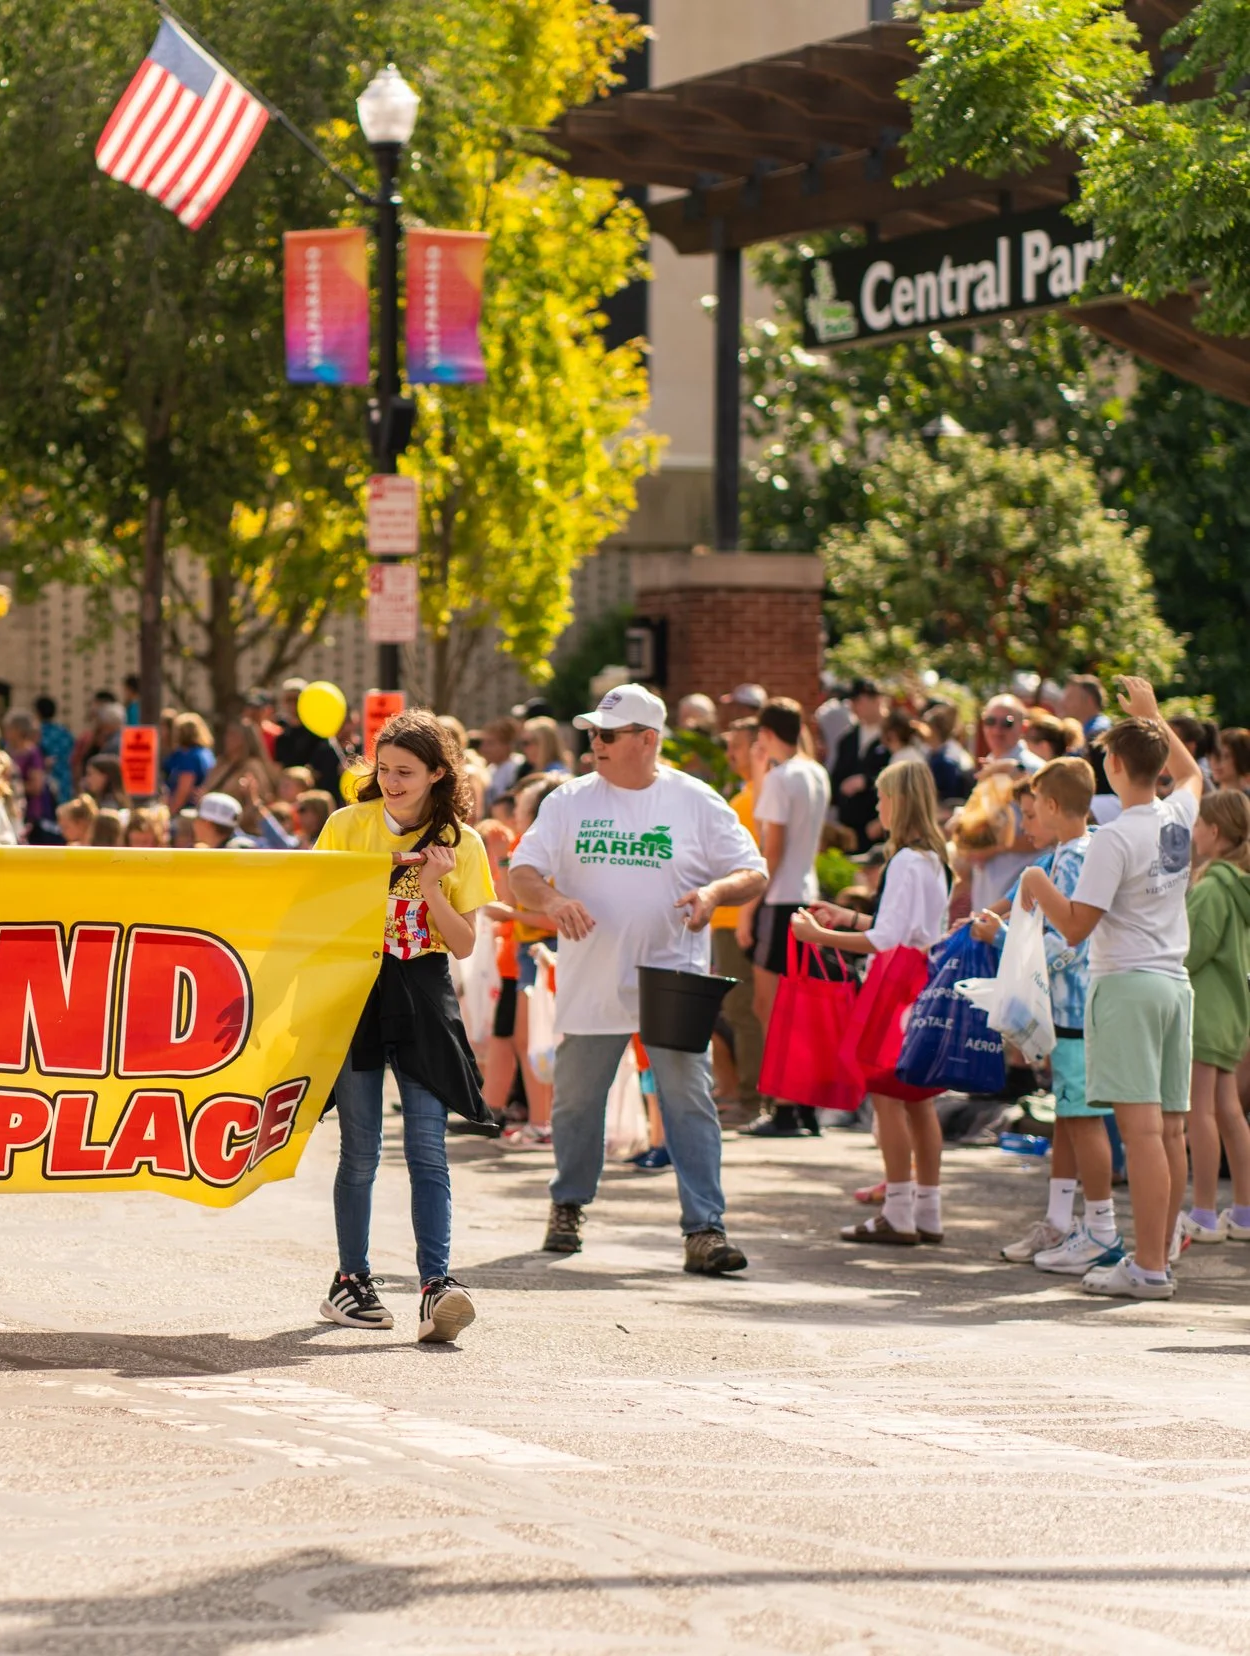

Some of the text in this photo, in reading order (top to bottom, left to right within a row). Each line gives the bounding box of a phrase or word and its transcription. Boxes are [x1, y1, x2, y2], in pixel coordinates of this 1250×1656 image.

[861, 236, 1011, 331] Central
[580, 819, 614, 828] ELECT
[578, 829, 635, 840] MICHELLE
[575, 839, 672, 859] HARRIS
[580, 856, 662, 869] CITY COUNCIL
